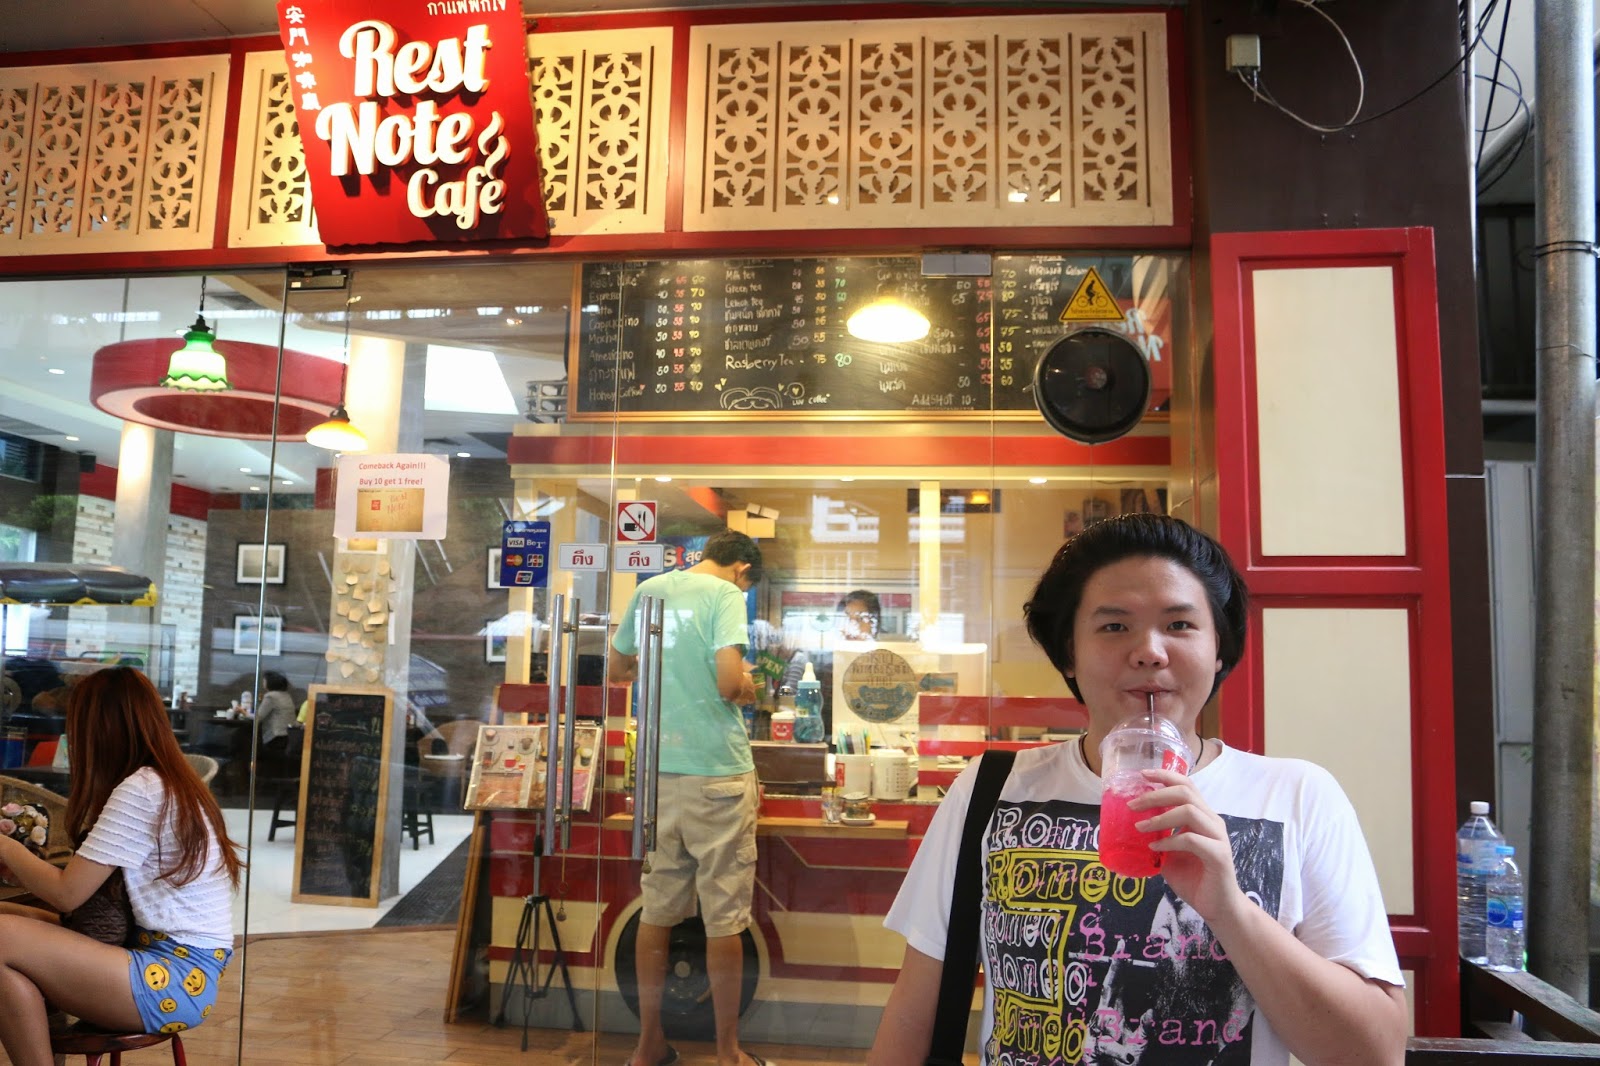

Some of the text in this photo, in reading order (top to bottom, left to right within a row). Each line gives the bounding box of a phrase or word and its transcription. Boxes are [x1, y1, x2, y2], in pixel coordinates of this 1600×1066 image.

[339, 20, 492, 97] Rest
[315, 100, 475, 177] Note
[835, 278, 846, 289] 70
[690, 288, 705, 297] 70
[952, 292, 968, 305] 65
[1002, 290, 1015, 302] 80
[1002, 309, 1022, 319] 75
[656, 318, 668, 327] 50
[792, 319, 805, 328] 50
[655, 331, 667, 342] 50
[792, 335, 809, 346] 50
[813, 332, 825, 342] 55
[656, 349, 666, 358] 40
[690, 347, 701, 356] 70
[998, 342, 1012, 353] 50
[835, 353, 852, 368] 80
[656, 365, 669, 376] 50
[673, 364, 684, 374] 55
[655, 384, 667, 393] 50
[690, 381, 703, 391] 70
[957, 376, 970, 388] 50
[1001, 375, 1013, 386] 60
[396, 462, 426, 470] Again!!!
[572, 549, 594, 565] ดึง
[628, 550, 650, 566] ดึง
[990, 807, 1100, 851] Rom
[987, 853, 1145, 906] Romeo
[1098, 1009, 1244, 1046] Brand
